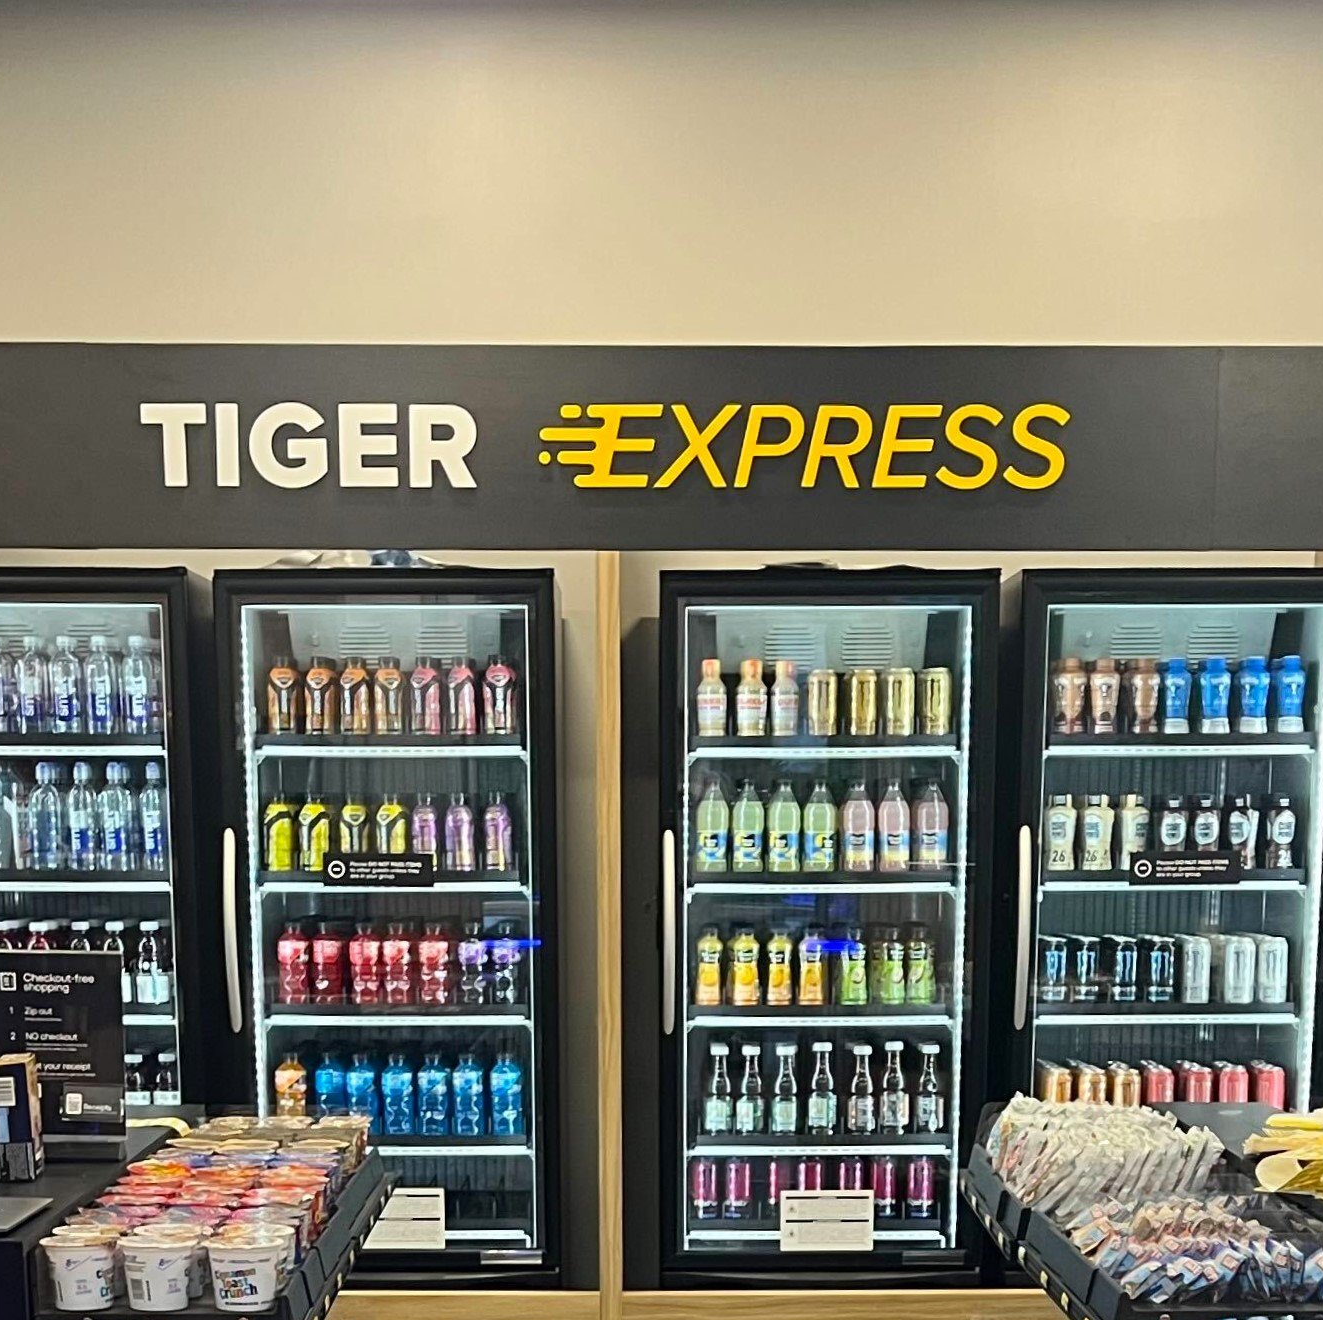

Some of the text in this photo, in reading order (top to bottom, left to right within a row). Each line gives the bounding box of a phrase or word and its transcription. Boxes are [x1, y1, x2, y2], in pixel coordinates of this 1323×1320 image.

[140, 402, 1071, 489] TIGER EXPRESS
[1052, 850, 1066, 863] 26
[1085, 850, 1097, 862] 26
[23, 972, 95, 984] Checkout-free
[23, 984, 69, 995] shopping
[10, 1032, 78, 1041] 2 NO checkout
[44, 1063, 61, 1071] your
[62, 1063, 91, 1071] receipt
